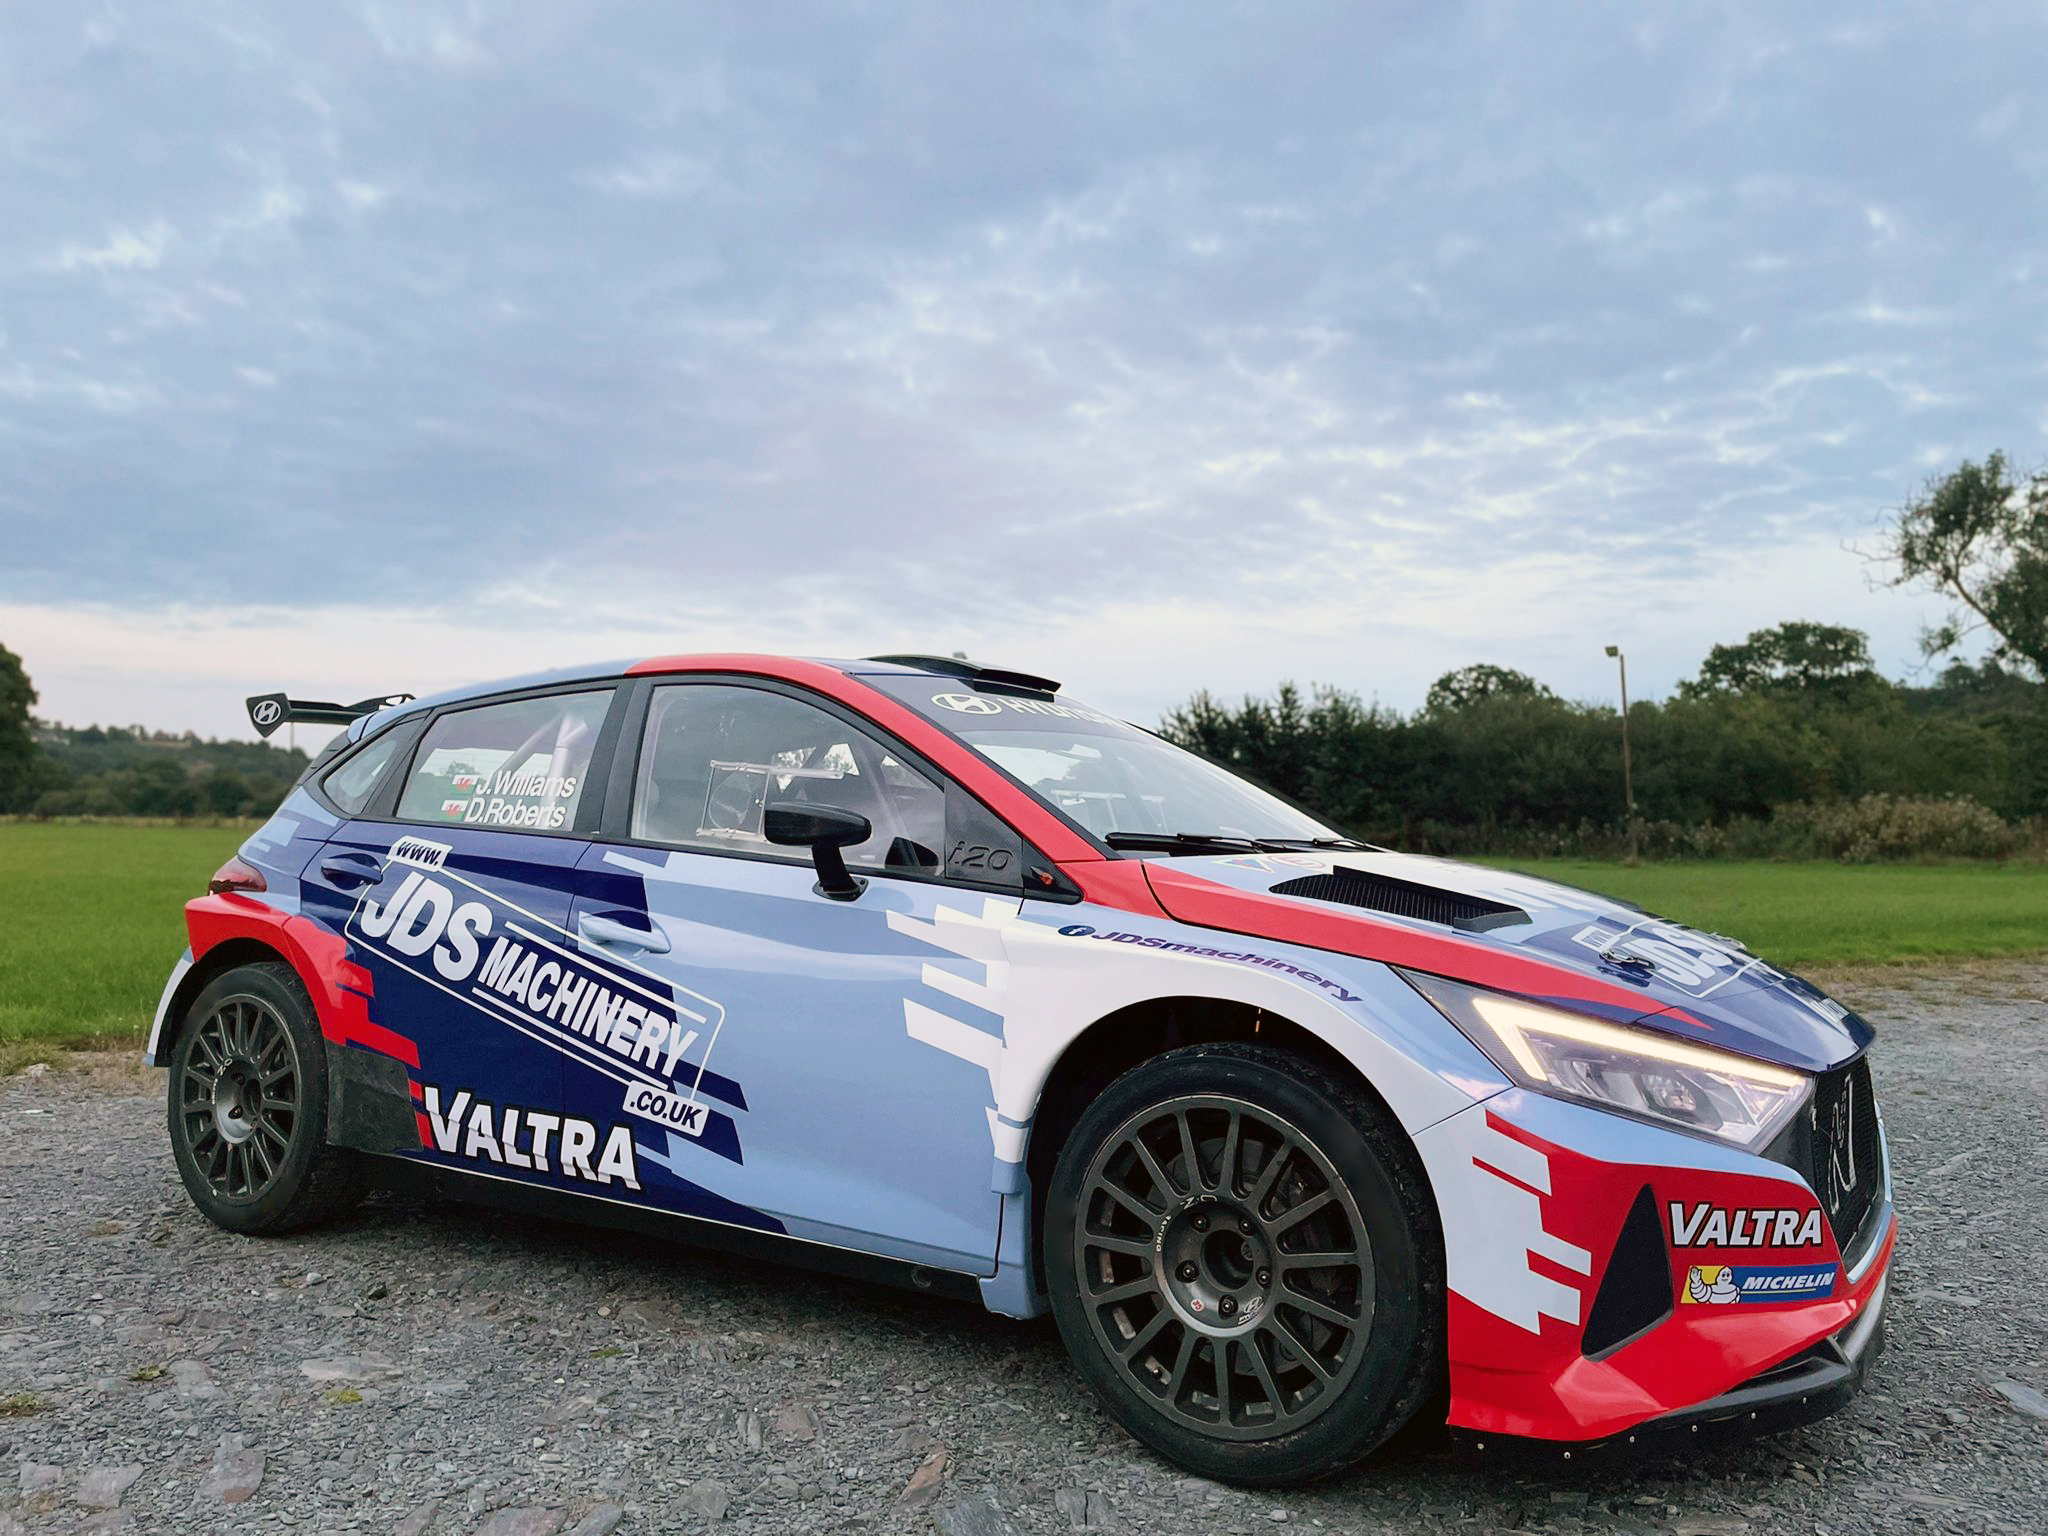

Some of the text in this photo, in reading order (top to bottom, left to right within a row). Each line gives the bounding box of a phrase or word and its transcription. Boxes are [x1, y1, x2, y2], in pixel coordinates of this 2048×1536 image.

[475, 770, 577, 798] J.Williams
[464, 797, 567, 828] D.Roberts
[360, 870, 699, 1078] JDS MACHINERY
[1091, 931, 1364, 1002] JDSmachinery
[629, 1090, 703, 1130] .CO.UK
[424, 1086, 642, 1191] VALTRA
[1669, 1202, 1823, 1247] VALTRA
[1742, 1271, 1836, 1290] MICHELIN
